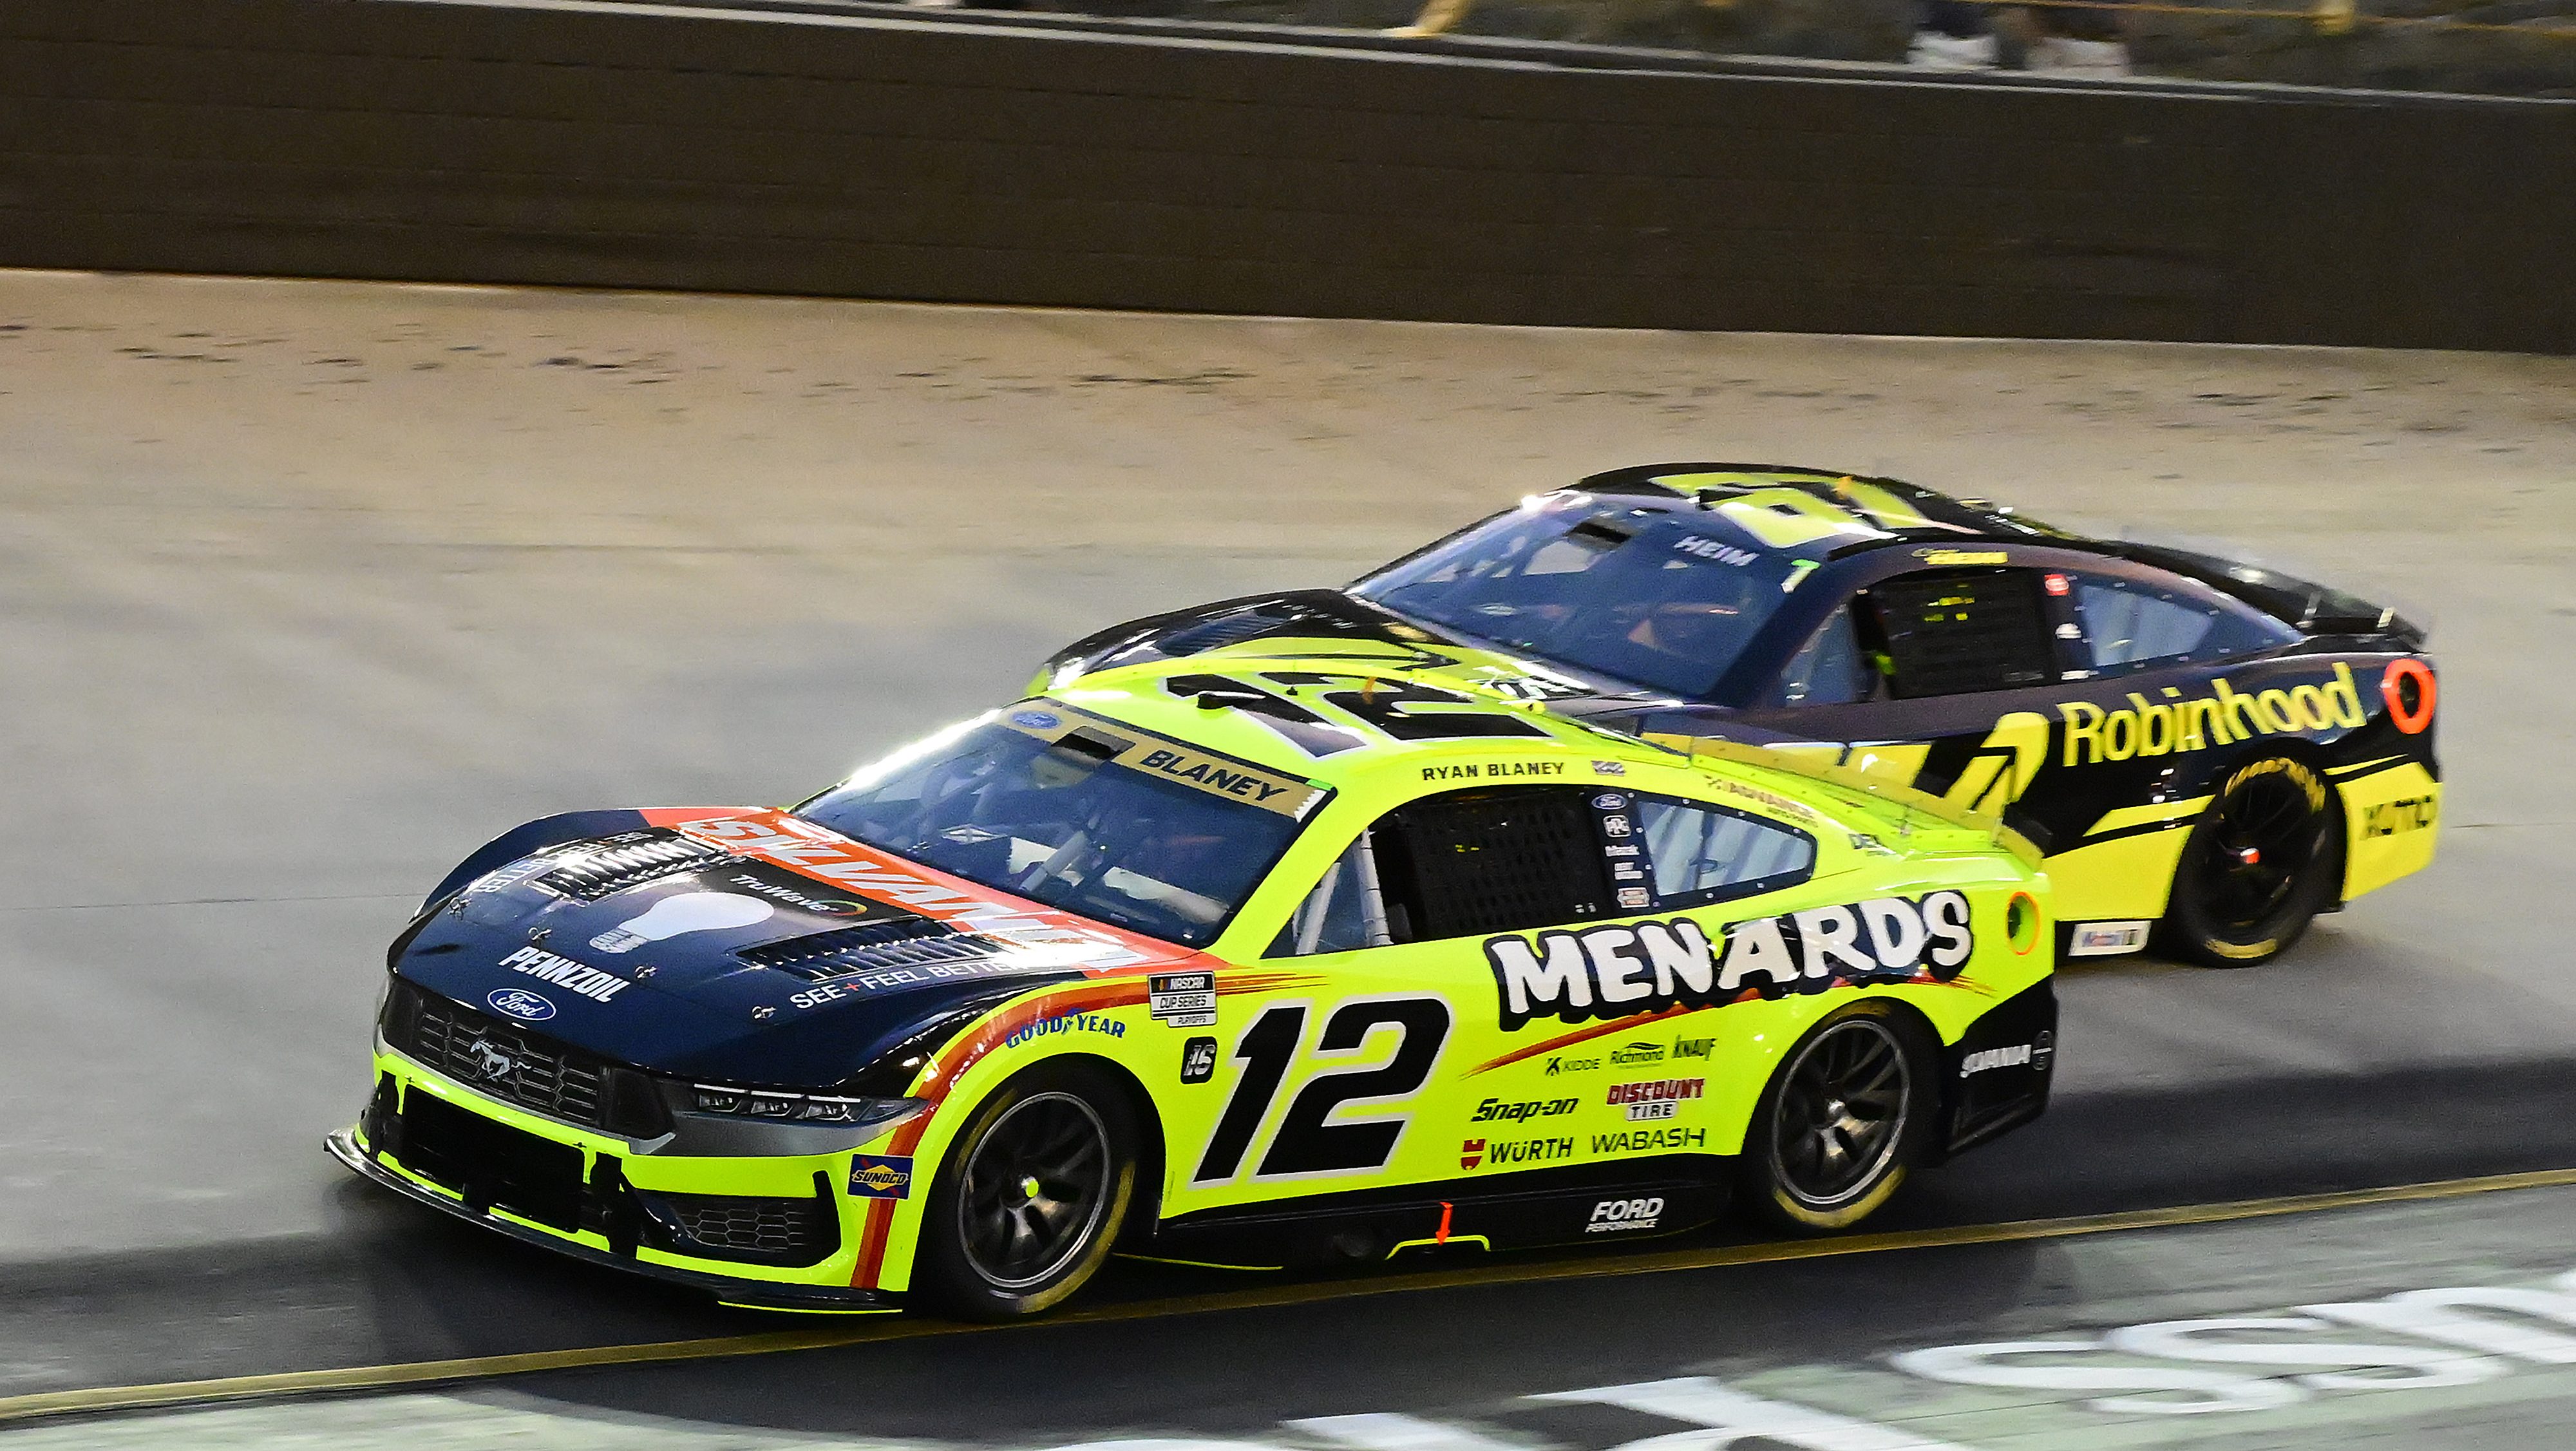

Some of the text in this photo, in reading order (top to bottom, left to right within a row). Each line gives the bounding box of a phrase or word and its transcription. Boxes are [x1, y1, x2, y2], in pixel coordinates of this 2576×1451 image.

[1674, 535, 1761, 567] HEIM
[2057, 662, 2367, 767] Robinhood
[1141, 750, 1289, 802] BLANEY
[1423, 761, 1565, 781] RYAN BLANEY
[729, 874, 831, 912] TruWave
[1488, 890, 1971, 1016] MENARDS
[498, 946, 630, 1003] PENNZOIL
[1170, 976, 1205, 990] NASCAR
[494, 989, 551, 1019] Ford
[1159, 995, 1207, 1009] CUP SERIES
[1190, 994, 1452, 1188] 12
[1606, 1078, 1706, 1105] DISCOUNT
[1470, 1097, 1580, 1123] Snap-on
[1631, 1103, 1673, 1119] TIRE
[1592, 1127, 1706, 1154] WABASH
[853, 1170, 909, 1186] SUNOCO
[1590, 1197, 1665, 1222] FORD
[1585, 1219, 1659, 1233] PERFORMANCE
